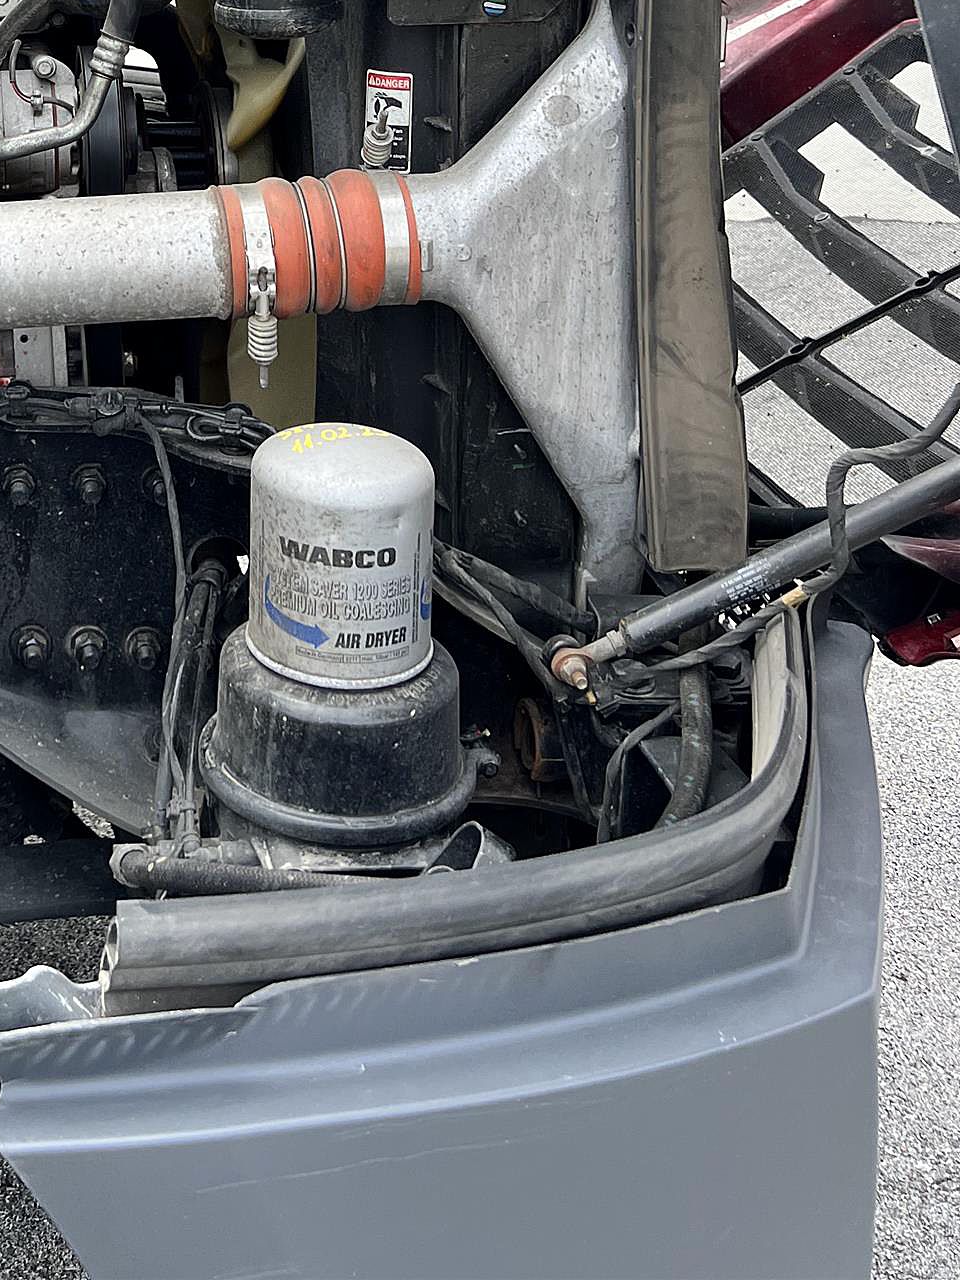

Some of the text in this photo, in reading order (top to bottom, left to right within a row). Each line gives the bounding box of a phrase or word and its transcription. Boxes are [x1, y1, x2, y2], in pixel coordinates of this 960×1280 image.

[375, 79, 409, 89] DANGER
[279, 535, 397, 568] WABCO
[271, 568, 411, 601] SYSTEM SAVER 1200 SERIES
[271, 586, 411, 621] PREMIUM OIL COALESCING
[335, 627, 407, 649] AIR DRYER
